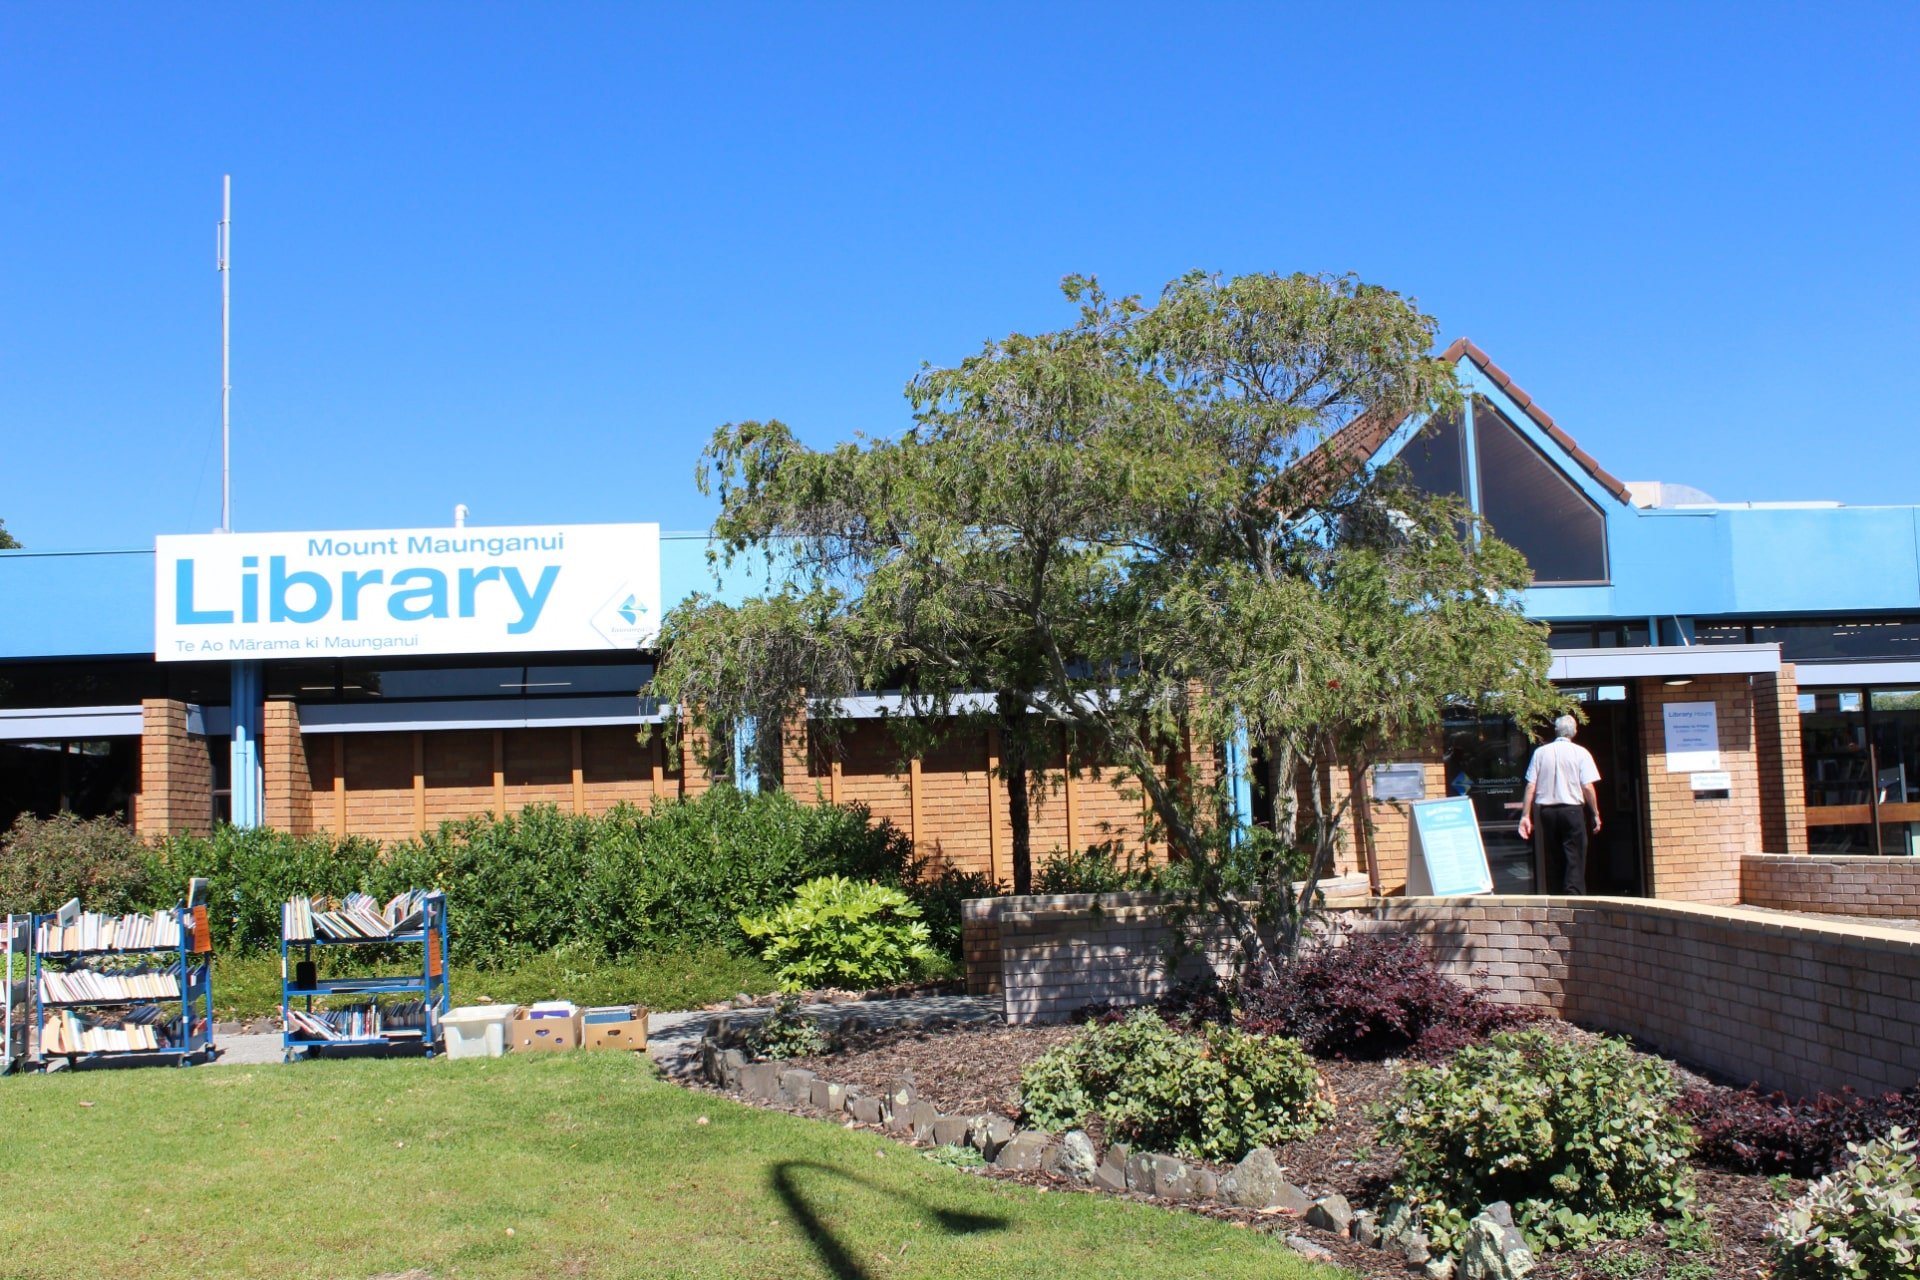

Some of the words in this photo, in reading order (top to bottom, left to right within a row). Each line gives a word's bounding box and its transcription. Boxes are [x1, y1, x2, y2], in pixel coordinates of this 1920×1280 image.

[308, 537, 398, 557] Mount
[408, 532, 564, 557] Maunganui
[175, 555, 562, 635] Library
[175, 640, 195, 652] Te
[200, 639, 224, 652] Ao
[229, 638, 301, 651] Mārama
[305, 637, 319, 650] ki
[324, 634, 419, 651] Maunganui
